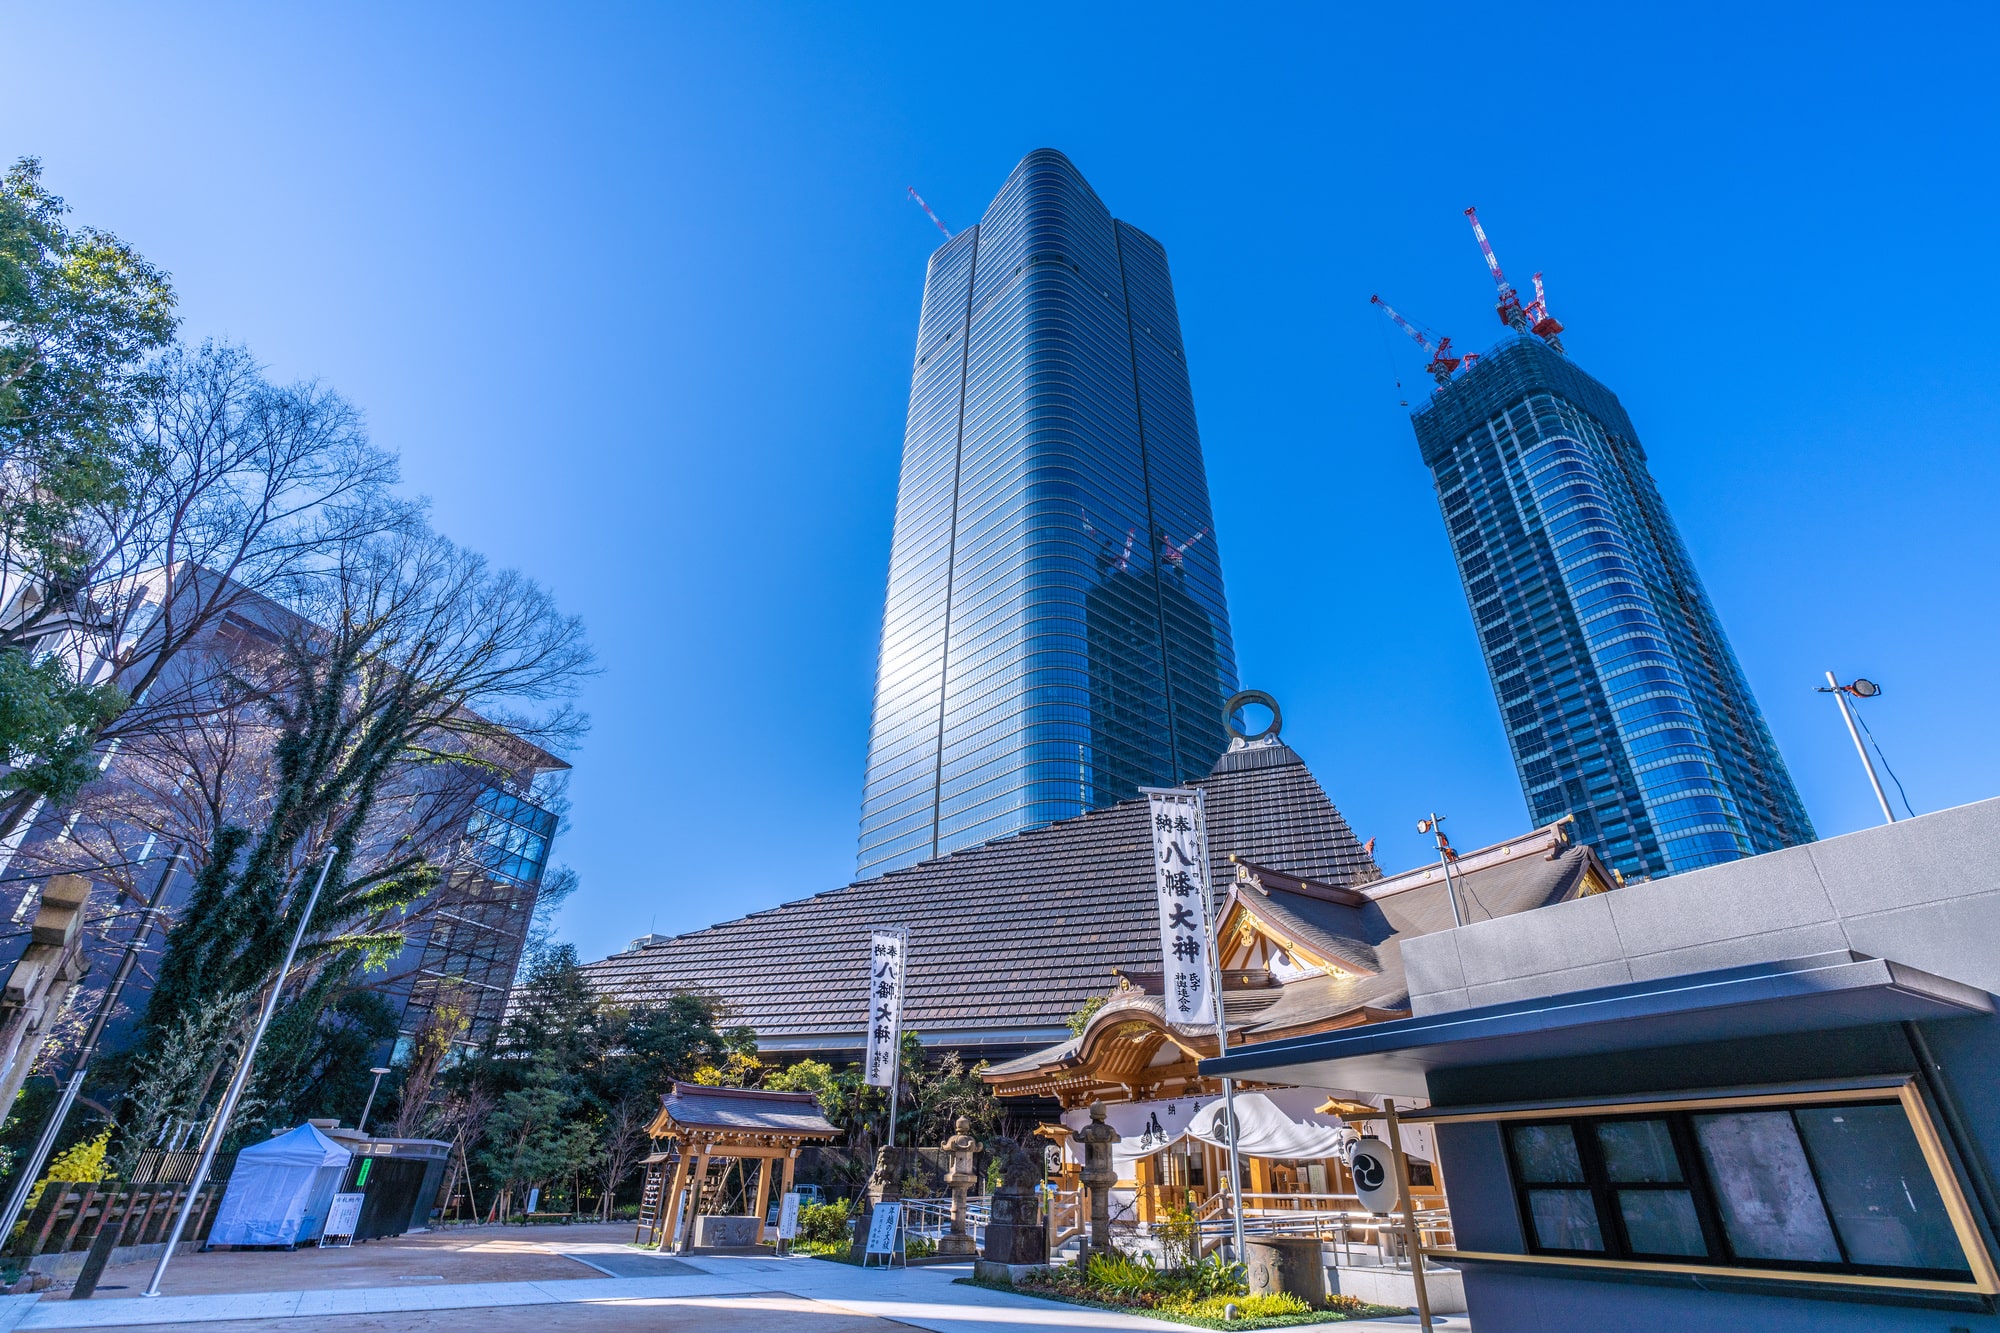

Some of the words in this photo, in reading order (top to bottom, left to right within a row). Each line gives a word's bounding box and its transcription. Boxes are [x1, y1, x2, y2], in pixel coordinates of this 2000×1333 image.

[1155, 813, 1192, 835] 奉納
[1163, 840, 1201, 964] 八幡大神
[1189, 972, 1201, 992] 氏子
